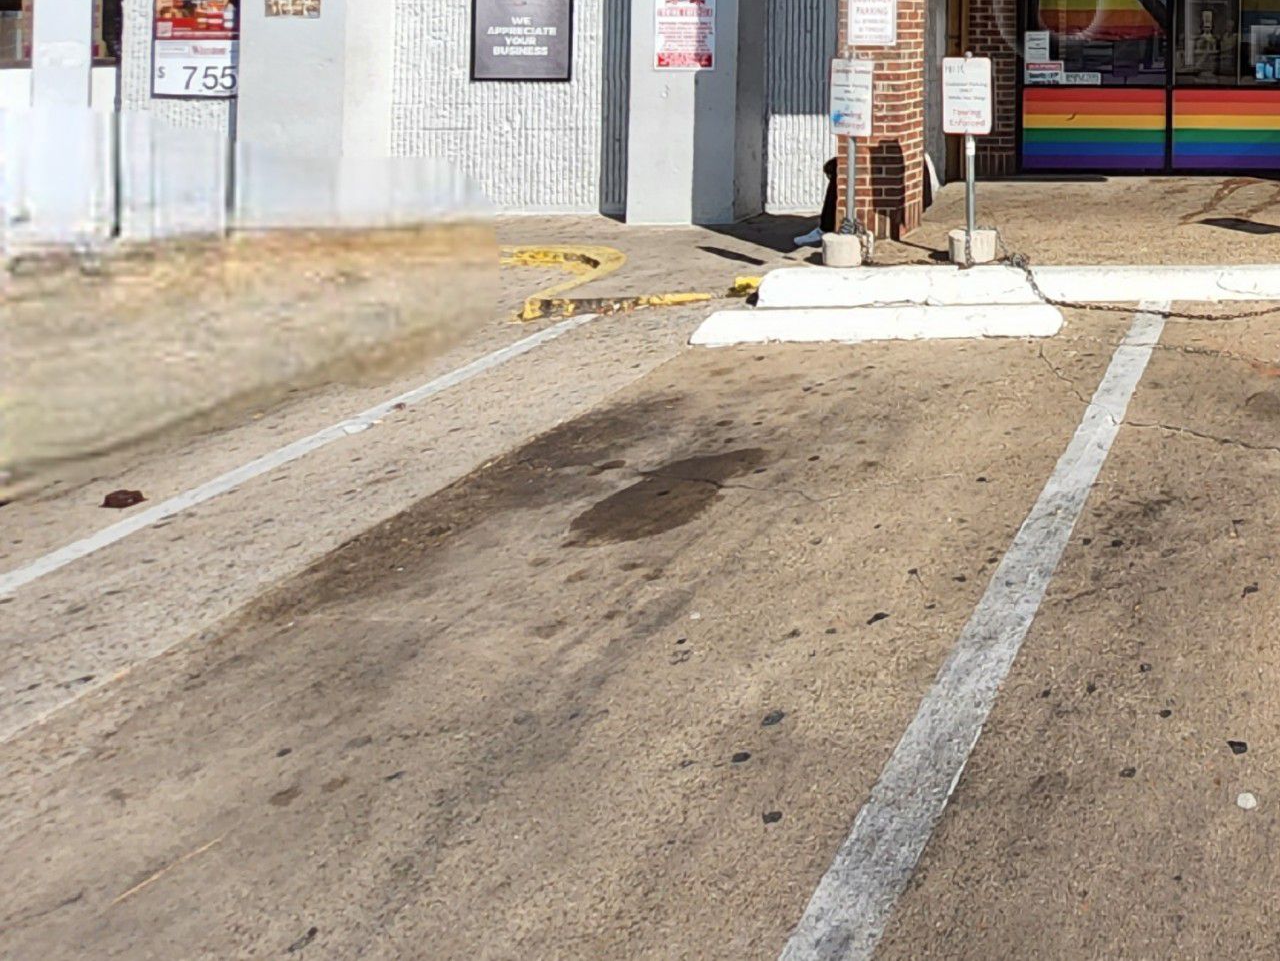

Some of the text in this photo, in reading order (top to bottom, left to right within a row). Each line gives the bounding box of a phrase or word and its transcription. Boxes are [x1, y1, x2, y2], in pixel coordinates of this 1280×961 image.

[511, 17, 531, 26] WE
[487, 26, 556, 36] APPRECIATE
[505, 37, 537, 46] YOUR
[493, 46, 548, 56] BUSINESS
